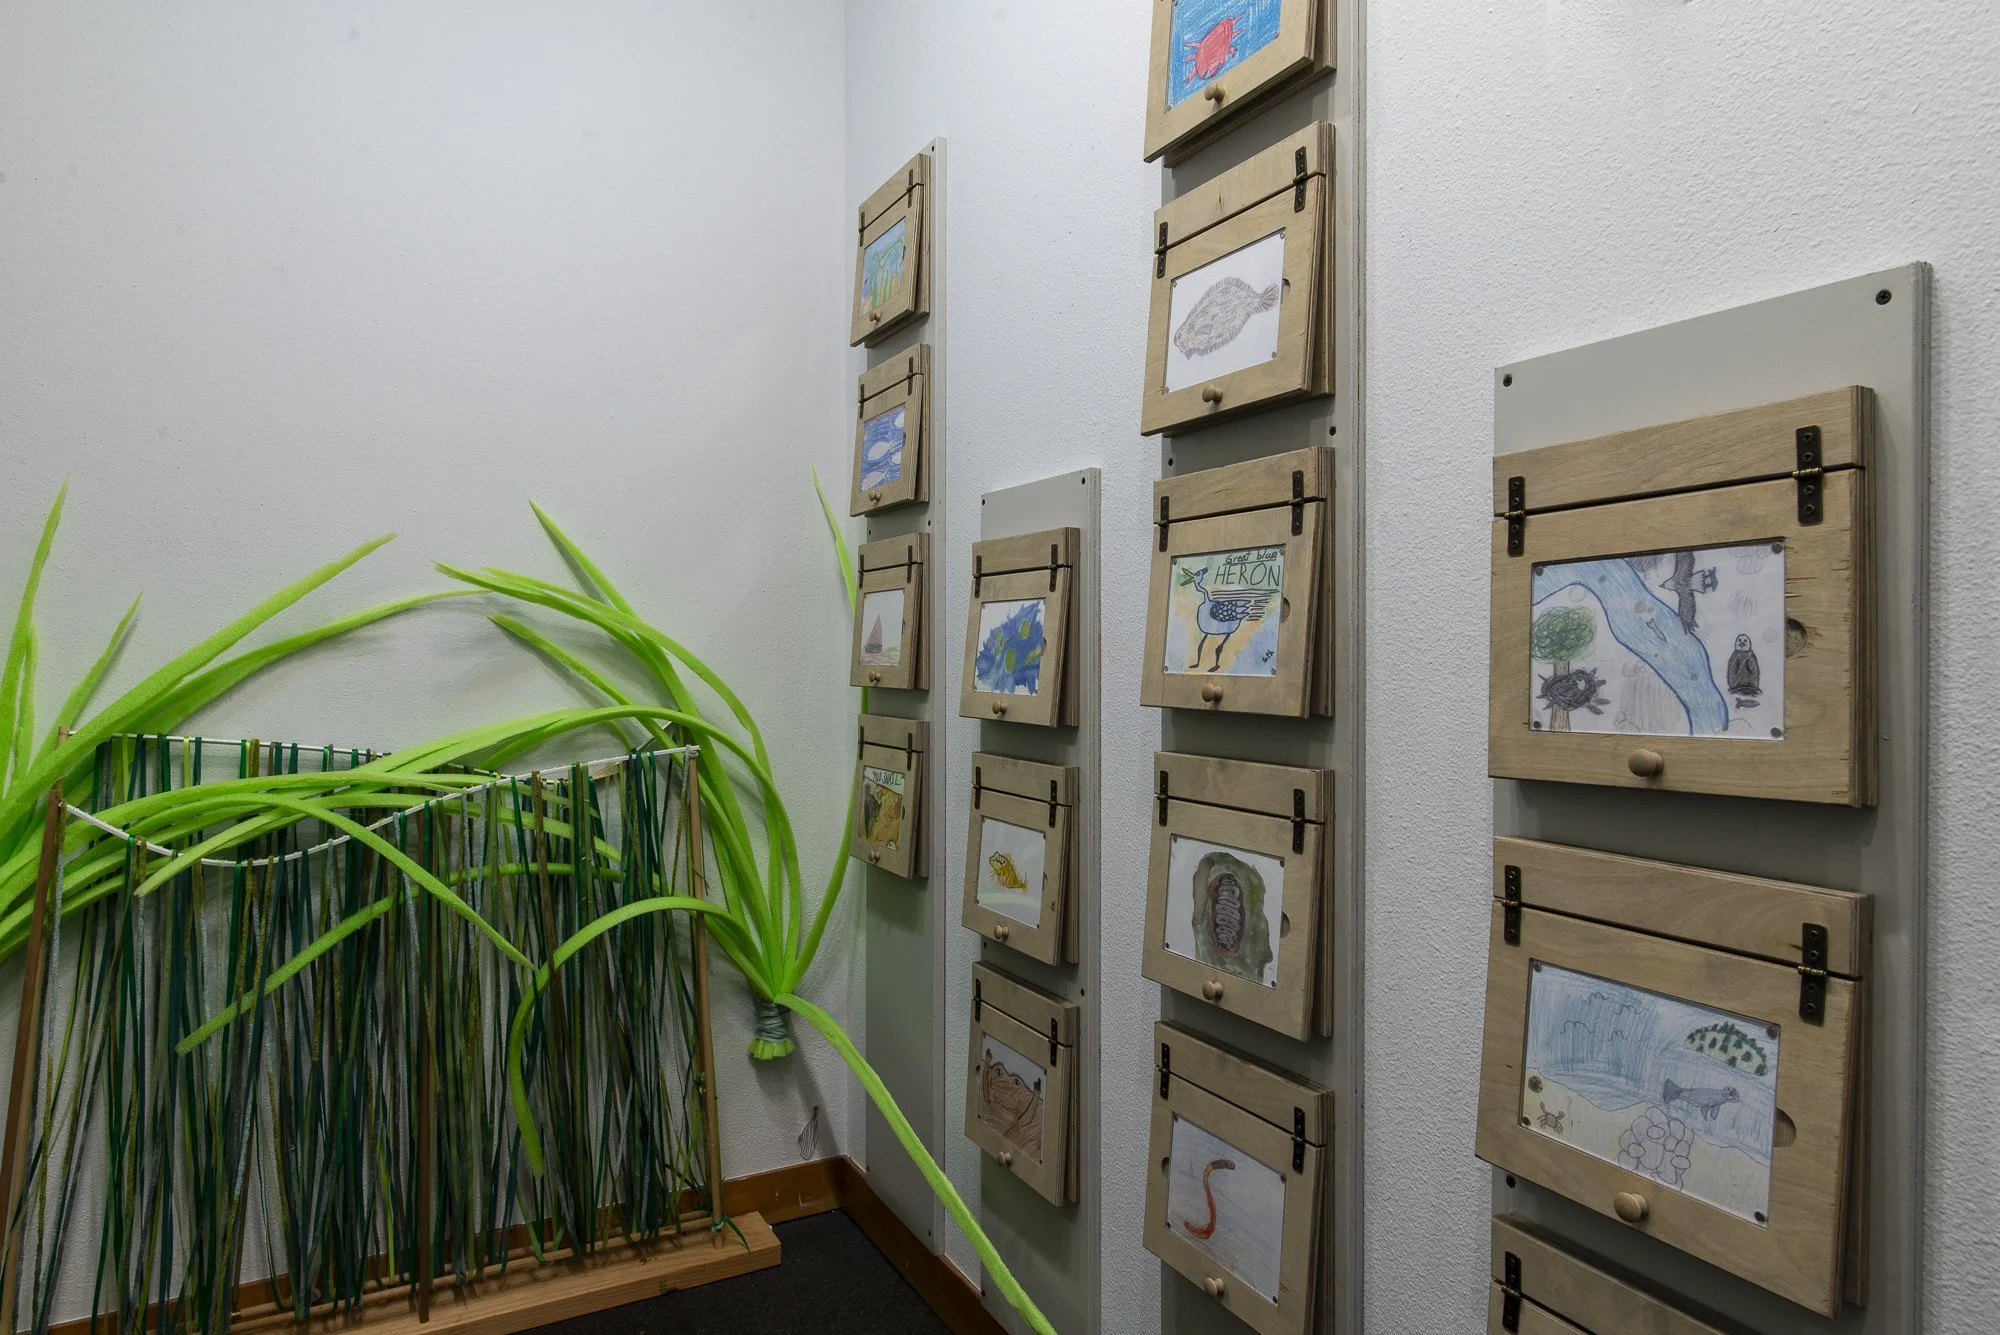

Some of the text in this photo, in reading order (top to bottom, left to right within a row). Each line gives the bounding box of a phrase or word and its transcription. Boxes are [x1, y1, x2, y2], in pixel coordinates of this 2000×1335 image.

[1225, 549, 1278, 563] Great blue
[1214, 562, 1281, 586] HERON
